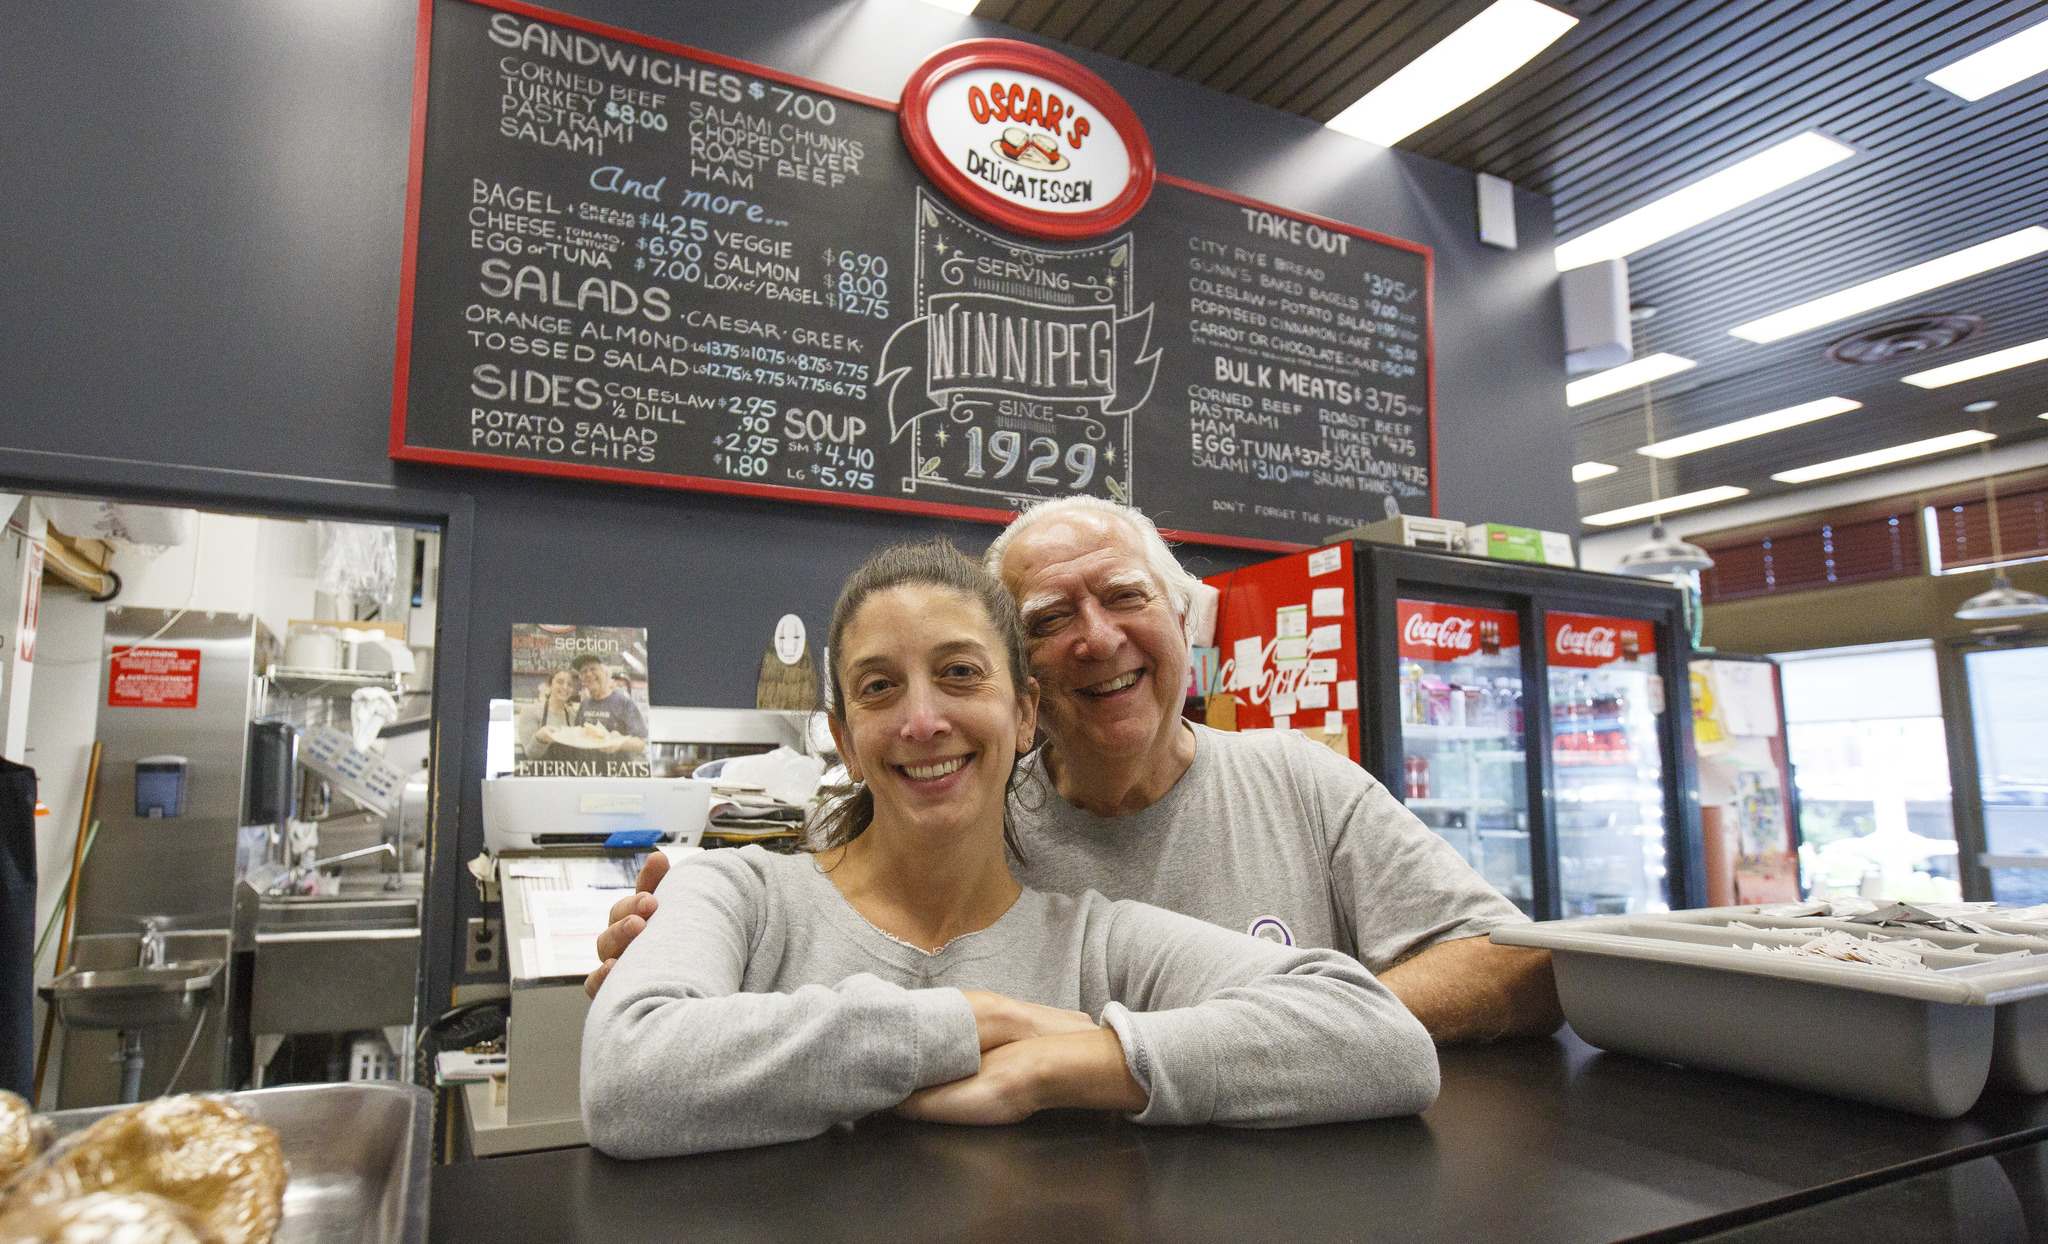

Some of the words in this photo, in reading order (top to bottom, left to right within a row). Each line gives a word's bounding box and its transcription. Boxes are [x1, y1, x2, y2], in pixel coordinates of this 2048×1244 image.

[487, 13, 742, 103] SANDWICHES
[500, 56, 604, 95] CORNED
[610, 84, 666, 109] BEEF
[501, 75, 596, 113] TURKEY
[604, 101, 668, 132] $8.00
[502, 95, 633, 144] PASTRAMI
[968, 82, 1090, 150] OSCAR'S
[500, 117, 603, 156] SALAMI
[688, 101, 772, 136] SALAMI
[779, 123, 864, 160] CHUNKS
[688, 119, 784, 157] CHOPPED
[791, 144, 860, 175] LIVER
[690, 137, 770, 172] ROAST
[776, 159, 846, 187] BEEF
[690, 159, 754, 190] HAM
[473, 178, 562, 215] BAGEL
[639, 211, 708, 241] $4.25
[713, 229, 792, 259] VEGGIE
[1241, 208, 1302, 245] TAKE
[1306, 225, 1350, 255] OUT
[472, 229, 523, 255] EGG
[545, 243, 612, 270] TUNA
[635, 236, 702, 262] $6.90
[713, 251, 799, 284] SALMON
[1188, 236, 1228, 256] CITY
[1234, 247, 1267, 267] RYE
[1274, 257, 1325, 281] BREAD
[479, 258, 672, 322] SALADS
[976, 256, 1071, 289] SERVING
[1260, 273, 1303, 296] BAKED
[1308, 287, 1360, 311] BAGELS
[1189, 277, 1266, 307] COLESLAW
[1280, 298, 1333, 323] POTATO
[1337, 312, 1376, 334] SALAD
[1190, 297, 1267, 327] POPPYSEED
[1270, 316, 1337, 342] CINNAMON
[1338, 332, 1371, 351] CAKE
[465, 304, 573, 336] ORANGE
[580, 321, 688, 352] ALMOND
[687, 310, 781, 341] CAESAR
[792, 327, 862, 353] GREEK
[930, 303, 1112, 388] WINNIPEG
[1189, 320, 1245, 342] CARROT
[1249, 331, 1269, 348] OR
[1270, 336, 1344, 365] CHOCOLATE
[1344, 353, 1379, 372] CAKE
[467, 330, 596, 363] TOSSED
[603, 349, 689, 377] SALAD
[471, 363, 602, 410] SIDES
[604, 382, 716, 410] COLESLAW
[1188, 384, 1253, 408] CORNED
[1261, 398, 1302, 416] BEEF
[1215, 356, 1272, 389] BULK
[1280, 368, 1353, 405] MEATS
[471, 408, 564, 434] POTATO
[574, 421, 658, 446] SALAD
[635, 402, 686, 425] DILL
[783, 407, 867, 445] SOUP
[998, 400, 1054, 421] SINCE
[1190, 399, 1279, 431] PASTRAMI
[1190, 418, 1236, 438] HAM
[1319, 408, 1370, 430] ROAST
[1374, 419, 1413, 436] BEEF
[471, 428, 565, 454] POTATO
[571, 439, 656, 463] CHIPS
[1320, 424, 1380, 447] TURKEY
[1321, 438, 1374, 462] LIVER
[813, 441, 875, 470] $4.40
[965, 426, 1097, 489] 1929
[1191, 433, 1235, 456] EGG
[1240, 439, 1293, 463] TUNA
[1333, 455, 1399, 479] SALMON
[1191, 450, 1249, 473] SALAMI
[1311, 469, 1356, 490] SALAMI
[786, 467, 806, 481] LG
[810, 463, 876, 489] $5.95
[1213, 500, 1246, 513] DON'T
[1255, 505, 1296, 519] FORGET
[1302, 511, 1320, 523] THE
[554, 635, 619, 651] section
[519, 760, 601, 777] ETERNAL
[607, 760, 650, 777] EATS
